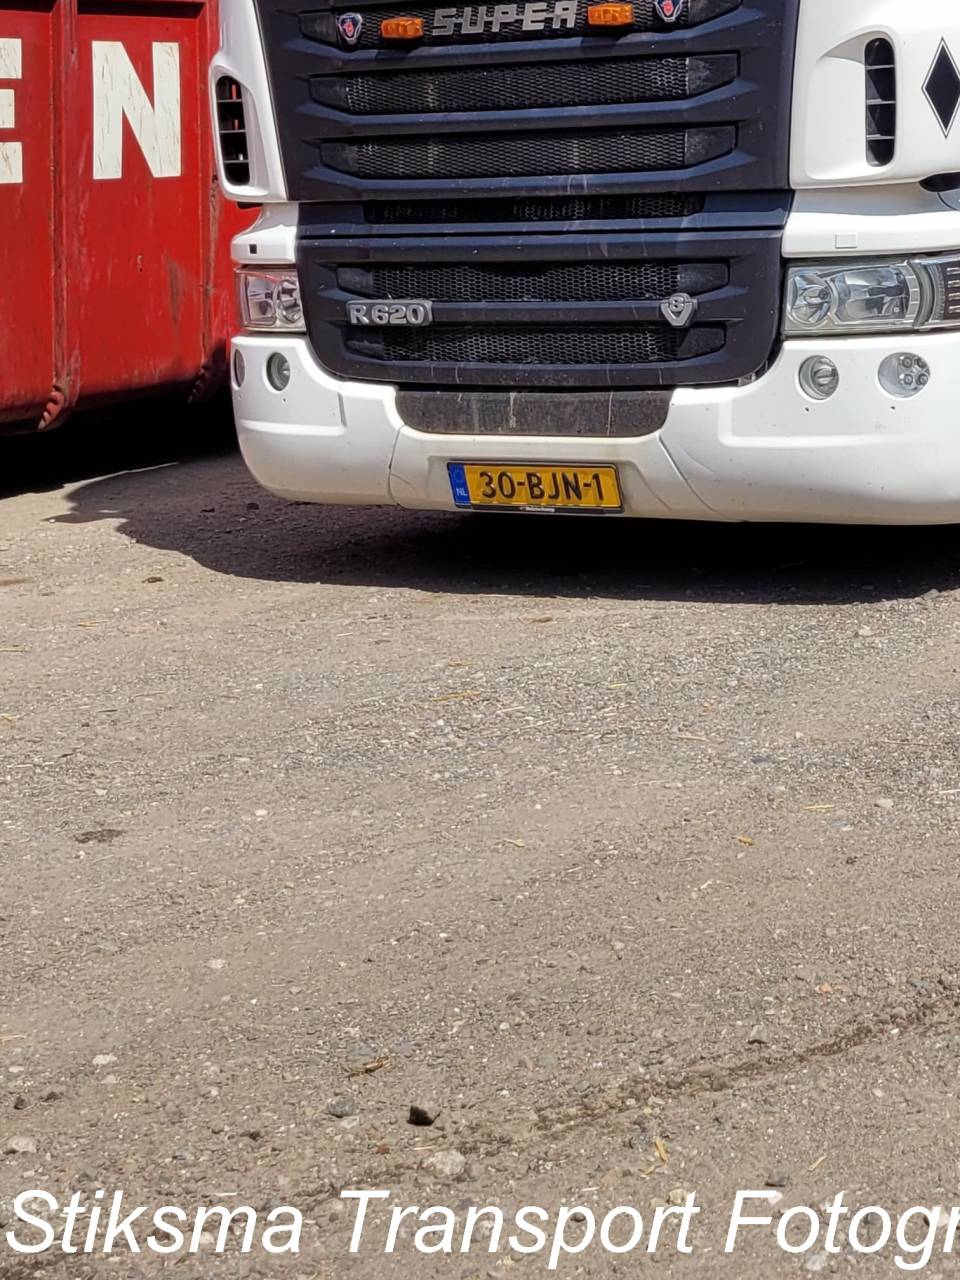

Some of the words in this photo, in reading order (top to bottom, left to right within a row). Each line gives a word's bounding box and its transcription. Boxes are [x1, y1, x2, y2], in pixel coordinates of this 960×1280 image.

[431, 0, 579, 36] SUPER
[349, 303, 370, 325] R
[371, 303, 425, 325] 620
[456, 487, 469, 497] NL
[479, 470, 605, 502] 30-BJN-1
